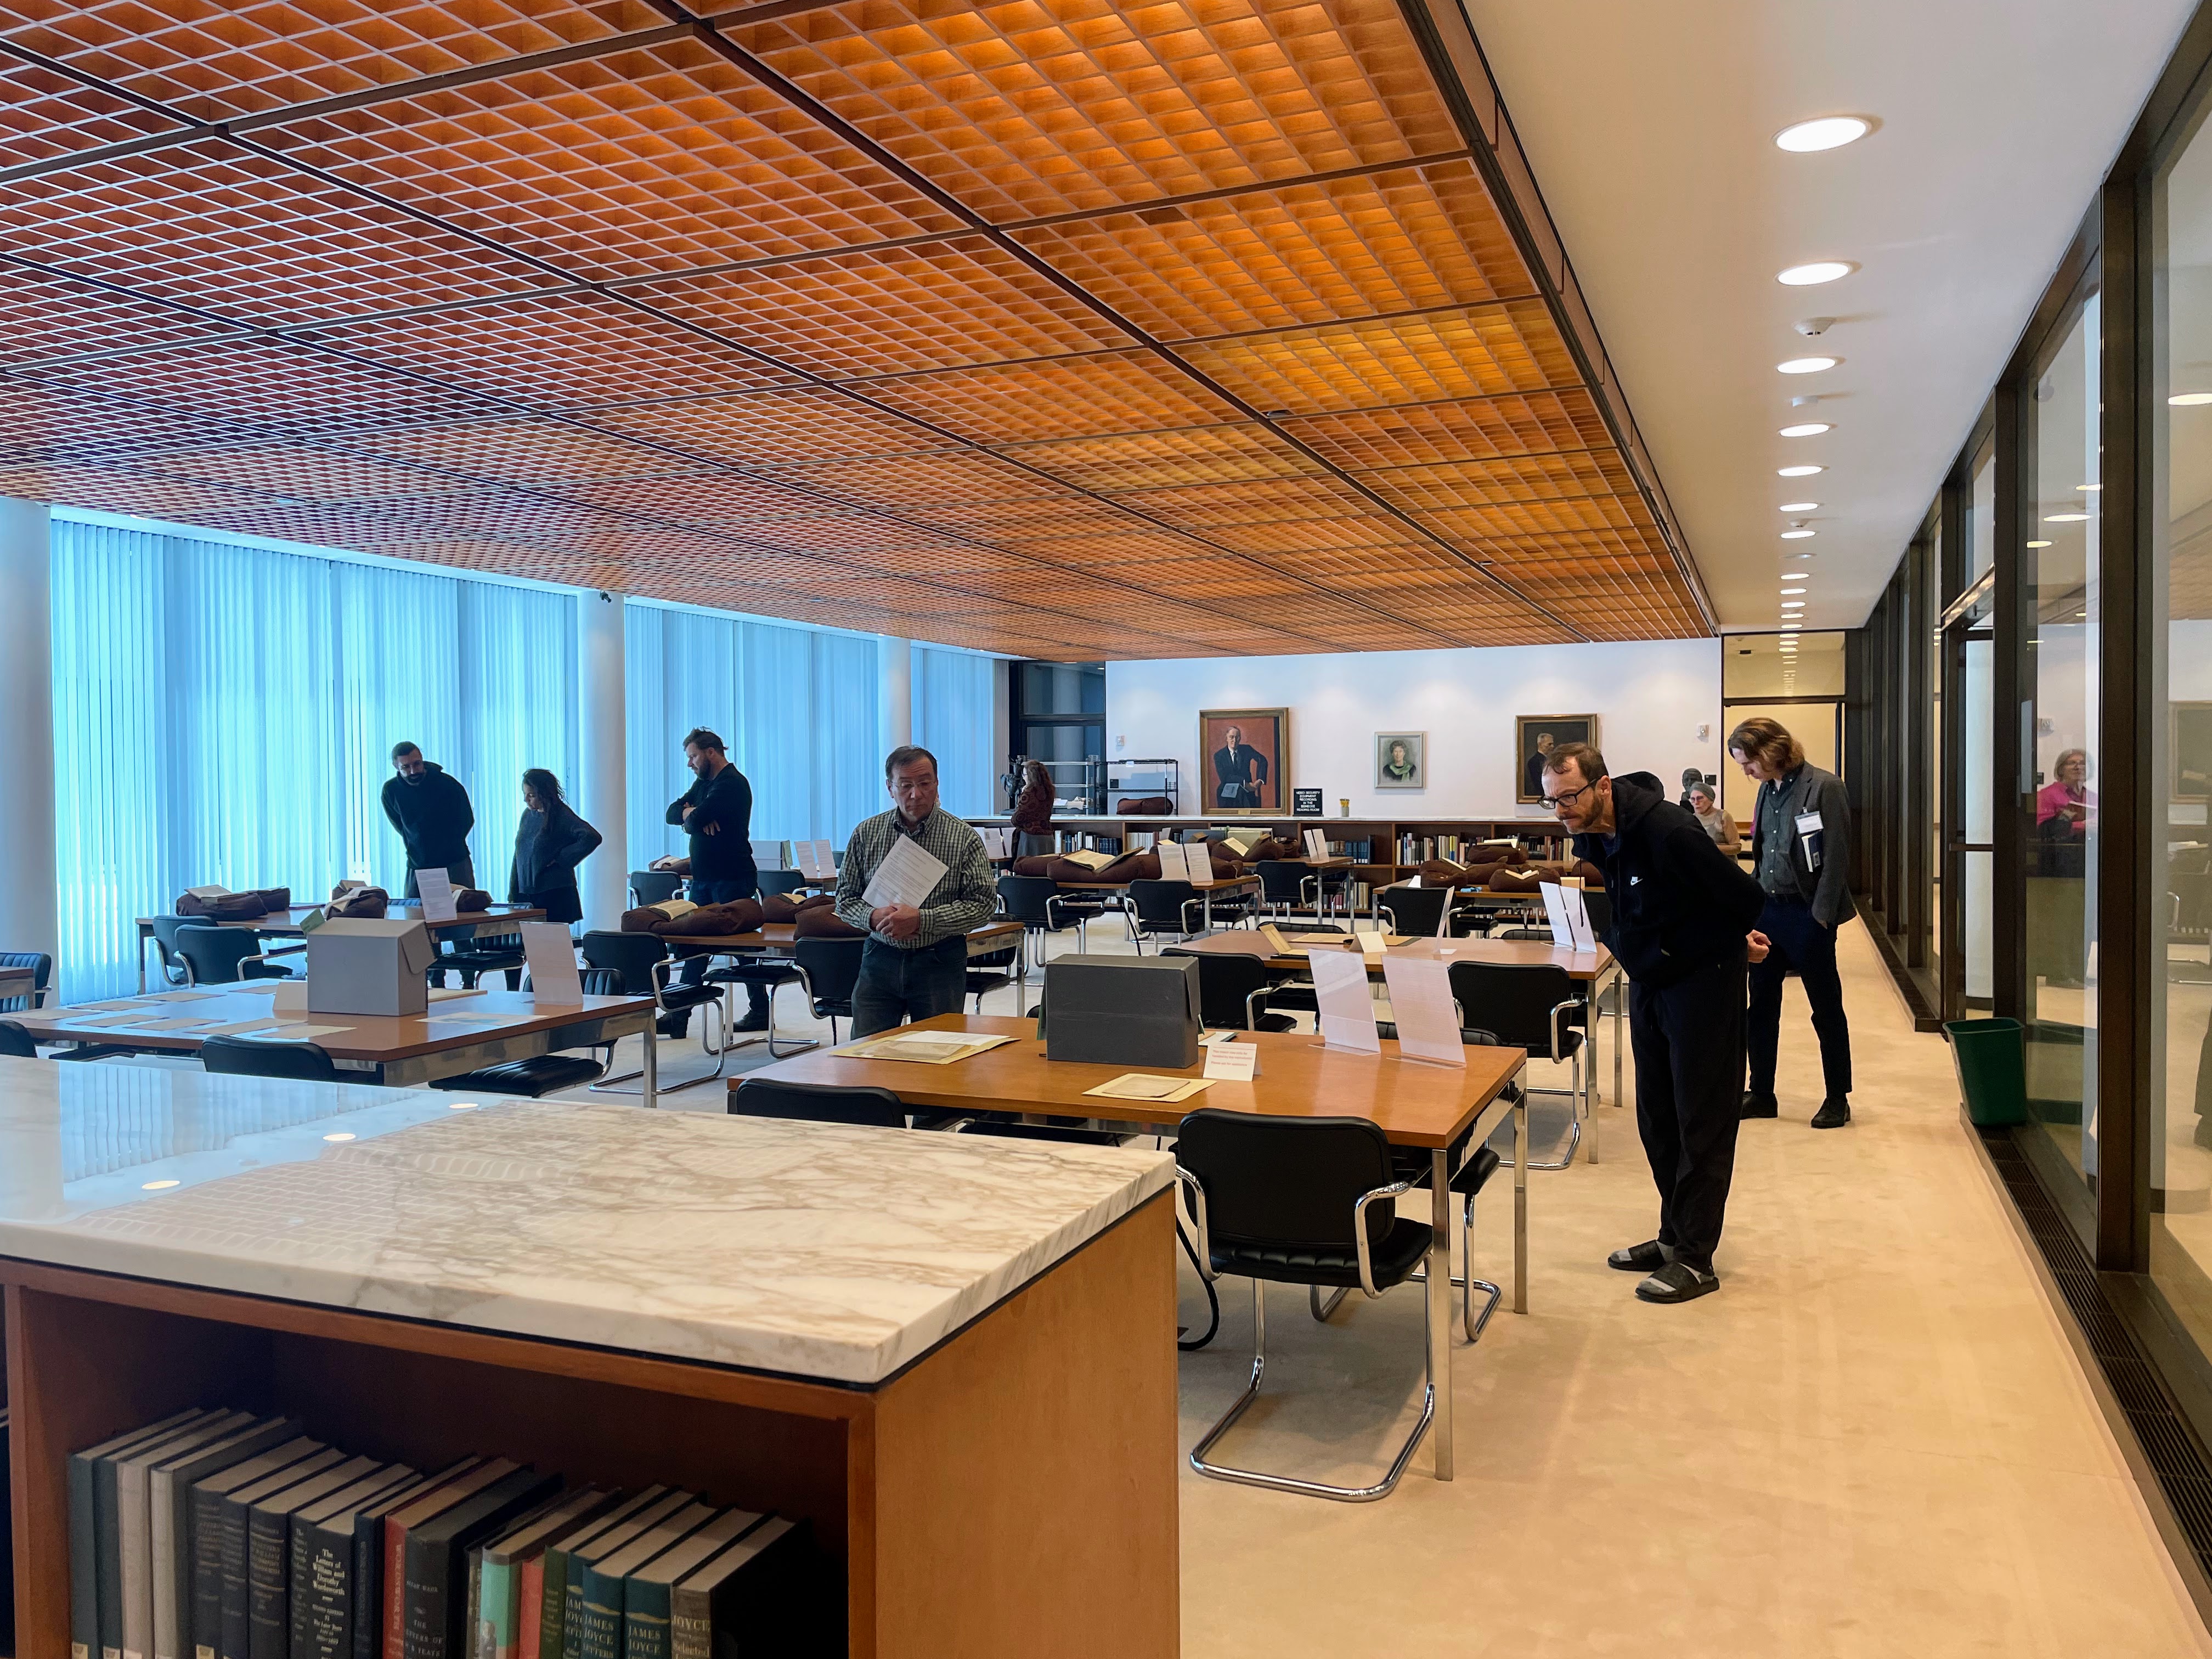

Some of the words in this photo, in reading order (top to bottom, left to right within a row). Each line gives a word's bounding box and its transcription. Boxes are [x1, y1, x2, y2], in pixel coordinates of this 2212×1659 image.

[315, 1554, 334, 1568] Letters
[322, 1548, 334, 1559] The
[313, 1562, 332, 1576] William
[313, 1580, 345, 1595] Wordsworth
[317, 1573, 340, 1588] Dorothy
[414, 1620, 427, 1629] THE
[584, 1613, 614, 1632] JAMES
[673, 1615, 711, 1633] JOYCE
[584, 1627, 613, 1645] JOYCE
[628, 1624, 661, 1640] JAMES
[418, 1647, 441, 1657] YEATS
[582, 1641, 613, 1658] LETTERS
[628, 1638, 661, 1655] JOYCE
[673, 1640, 710, 1657] Selected
